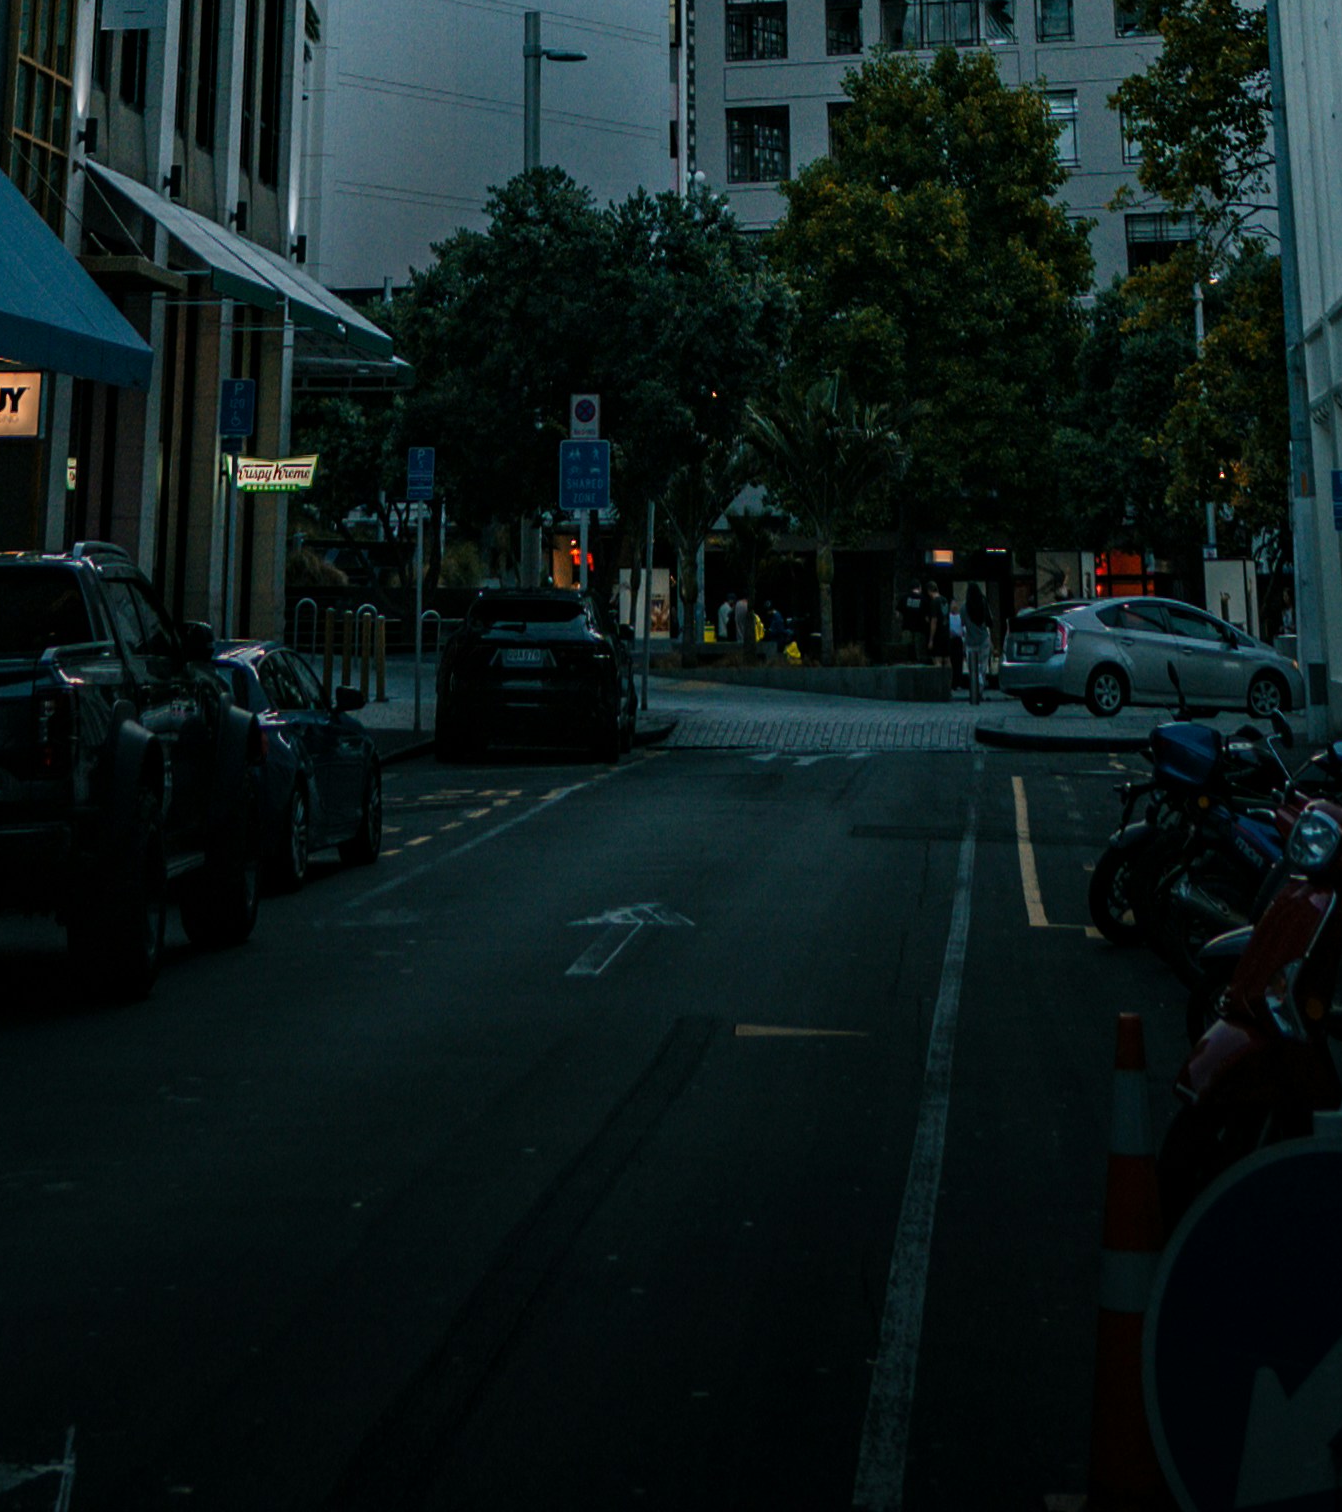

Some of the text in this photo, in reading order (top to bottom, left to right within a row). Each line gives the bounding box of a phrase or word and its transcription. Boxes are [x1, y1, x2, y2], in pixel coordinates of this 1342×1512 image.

[235, 382, 245, 396] P
[273, 463, 310, 481] Kreme
[565, 478, 604, 490] SHARED
[573, 492, 597, 504] ZONE
